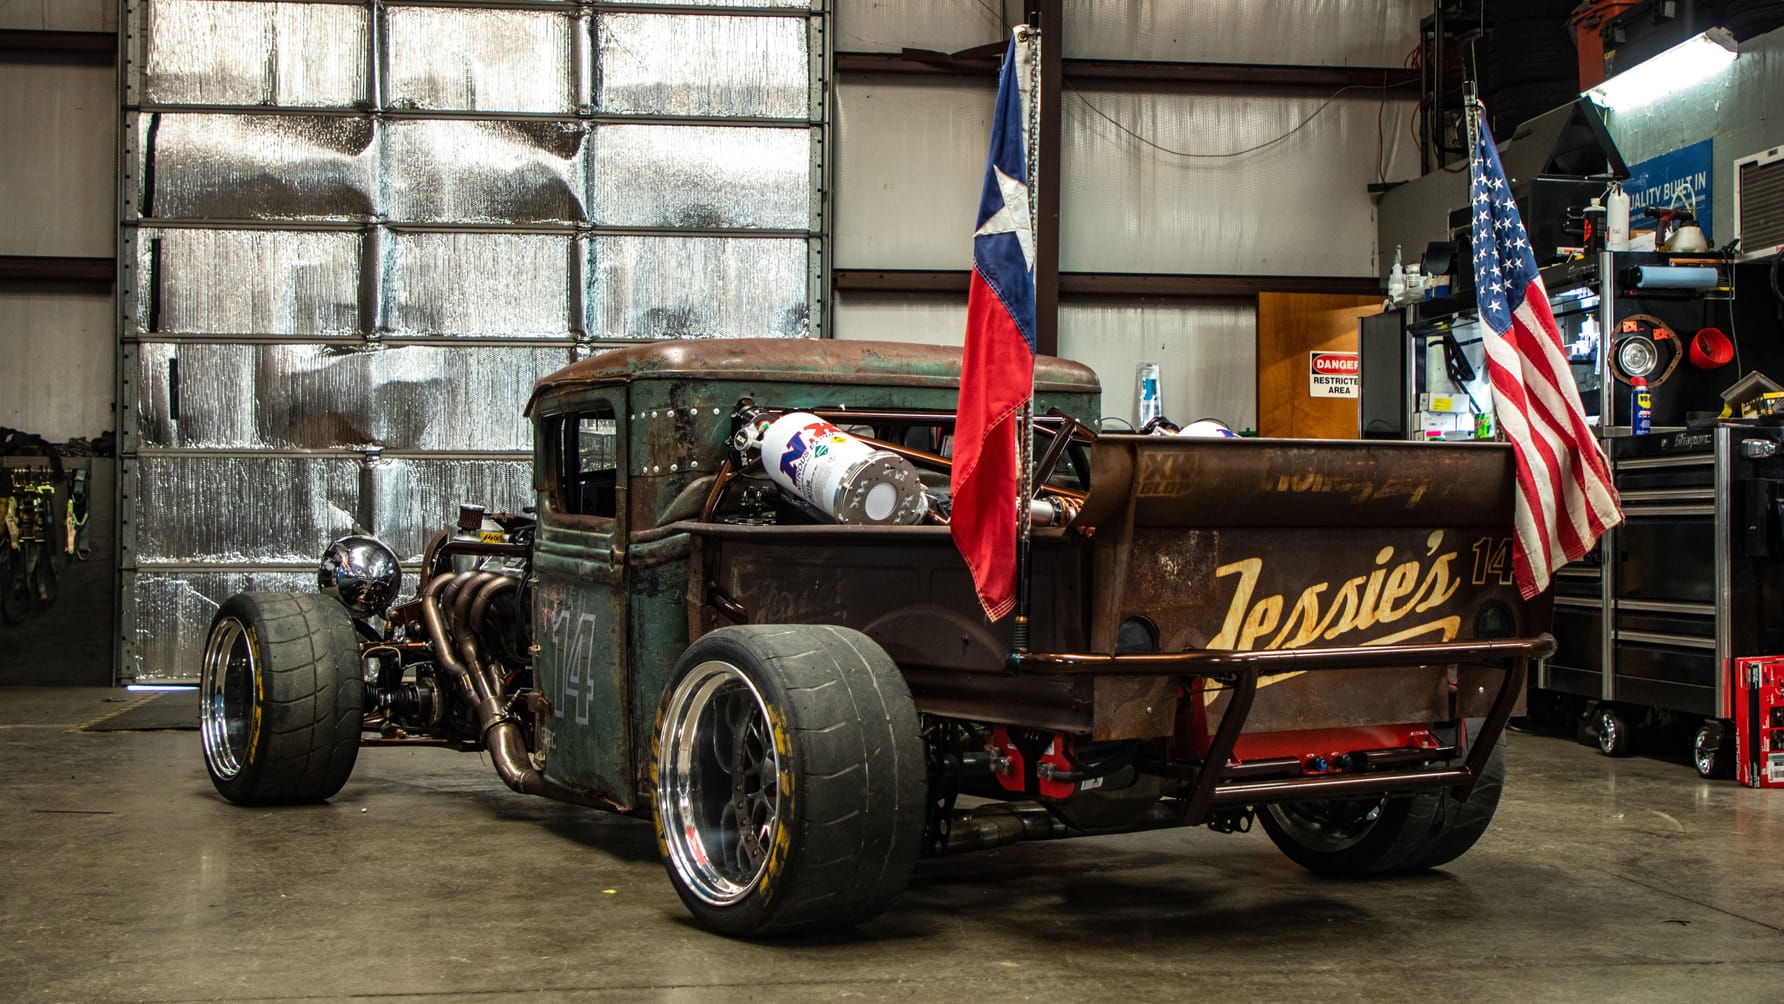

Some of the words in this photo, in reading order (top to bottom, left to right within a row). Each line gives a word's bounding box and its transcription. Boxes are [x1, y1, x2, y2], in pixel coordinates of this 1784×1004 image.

[1629, 185, 1662, 211] UALITY
[1663, 176, 1693, 201] BUILT
[1695, 171, 1707, 191] IN
[1313, 376, 1359, 385] RESTRICTE
[1328, 386, 1351, 394] AREA
[1472, 536, 1515, 586] 14
[552, 609, 596, 726] 14
